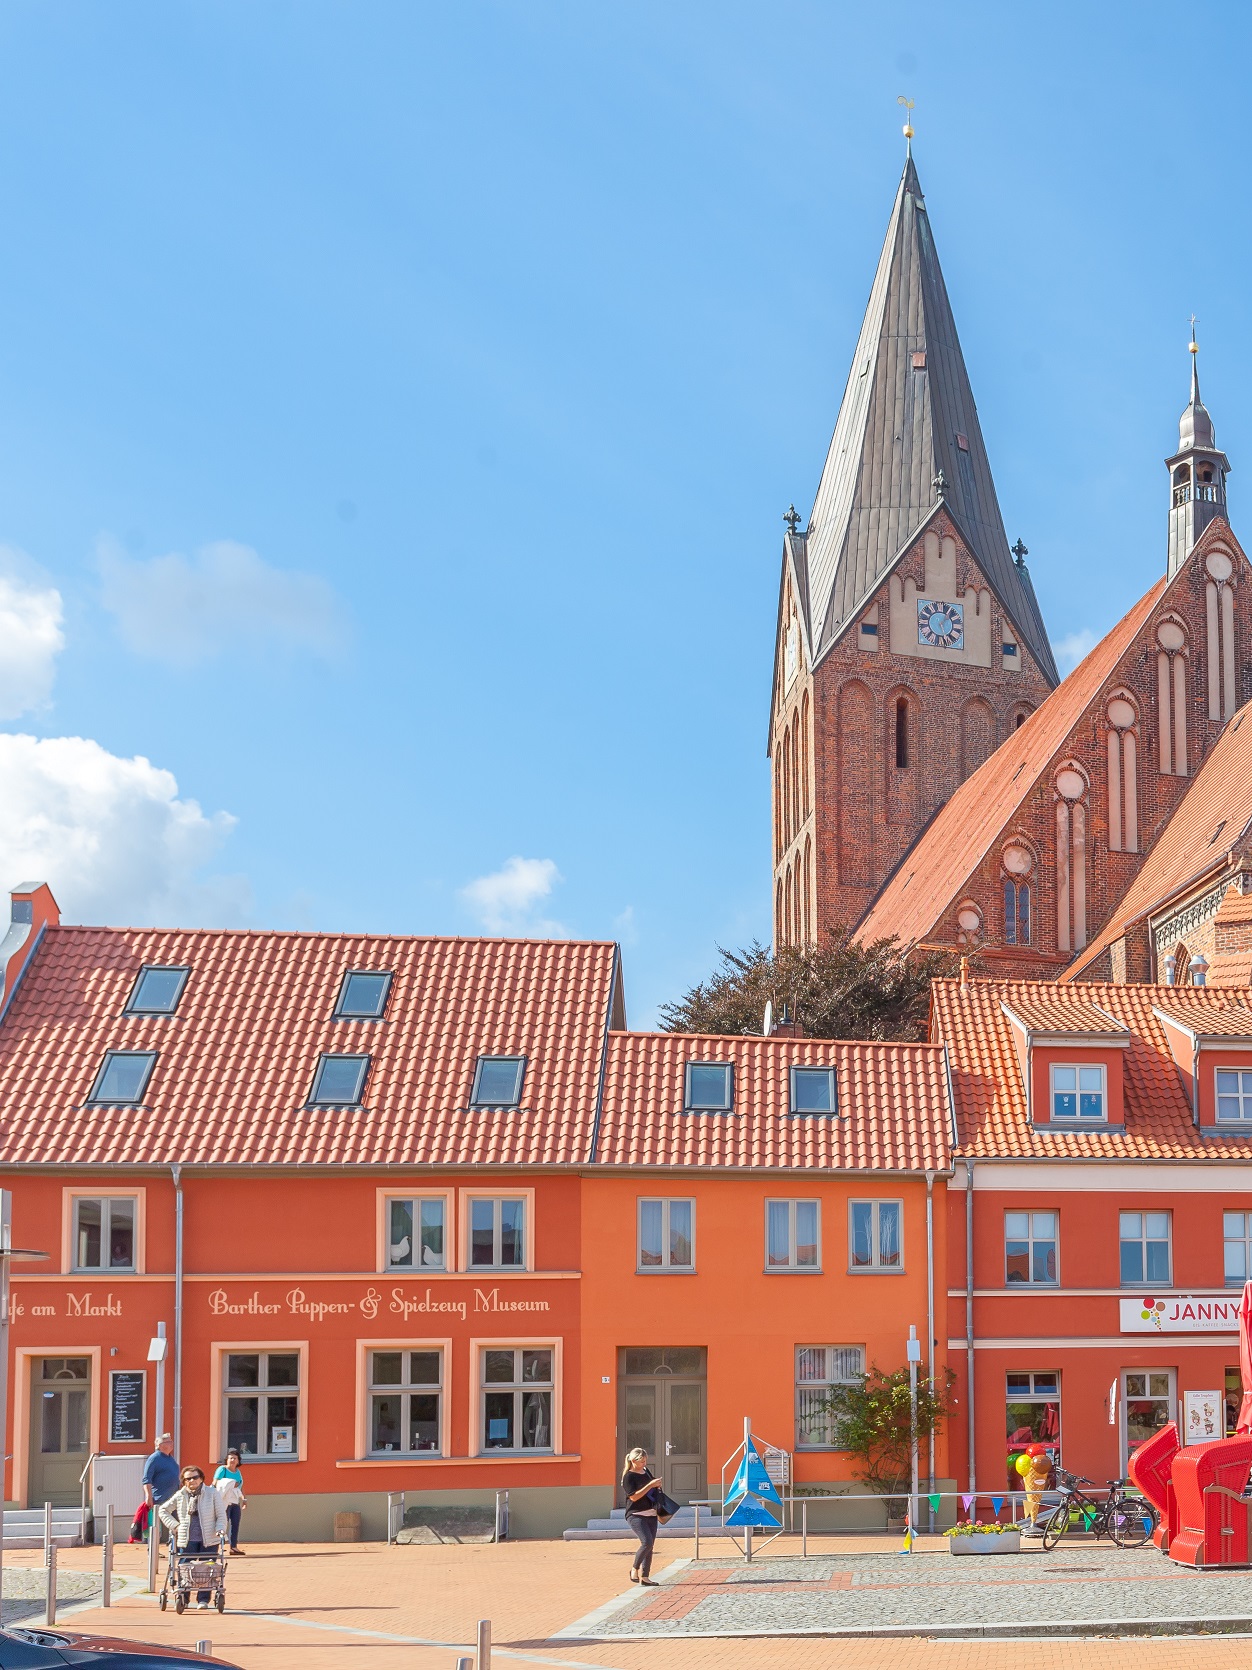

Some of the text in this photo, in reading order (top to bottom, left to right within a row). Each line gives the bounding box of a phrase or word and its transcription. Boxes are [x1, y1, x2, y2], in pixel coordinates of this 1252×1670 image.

[8, 1292, 122, 1325] fé am Markt
[208, 1287, 550, 1322] Barther Puppen- & Spielzeug Museum
[1169, 1303, 1240, 1321] JANNY
